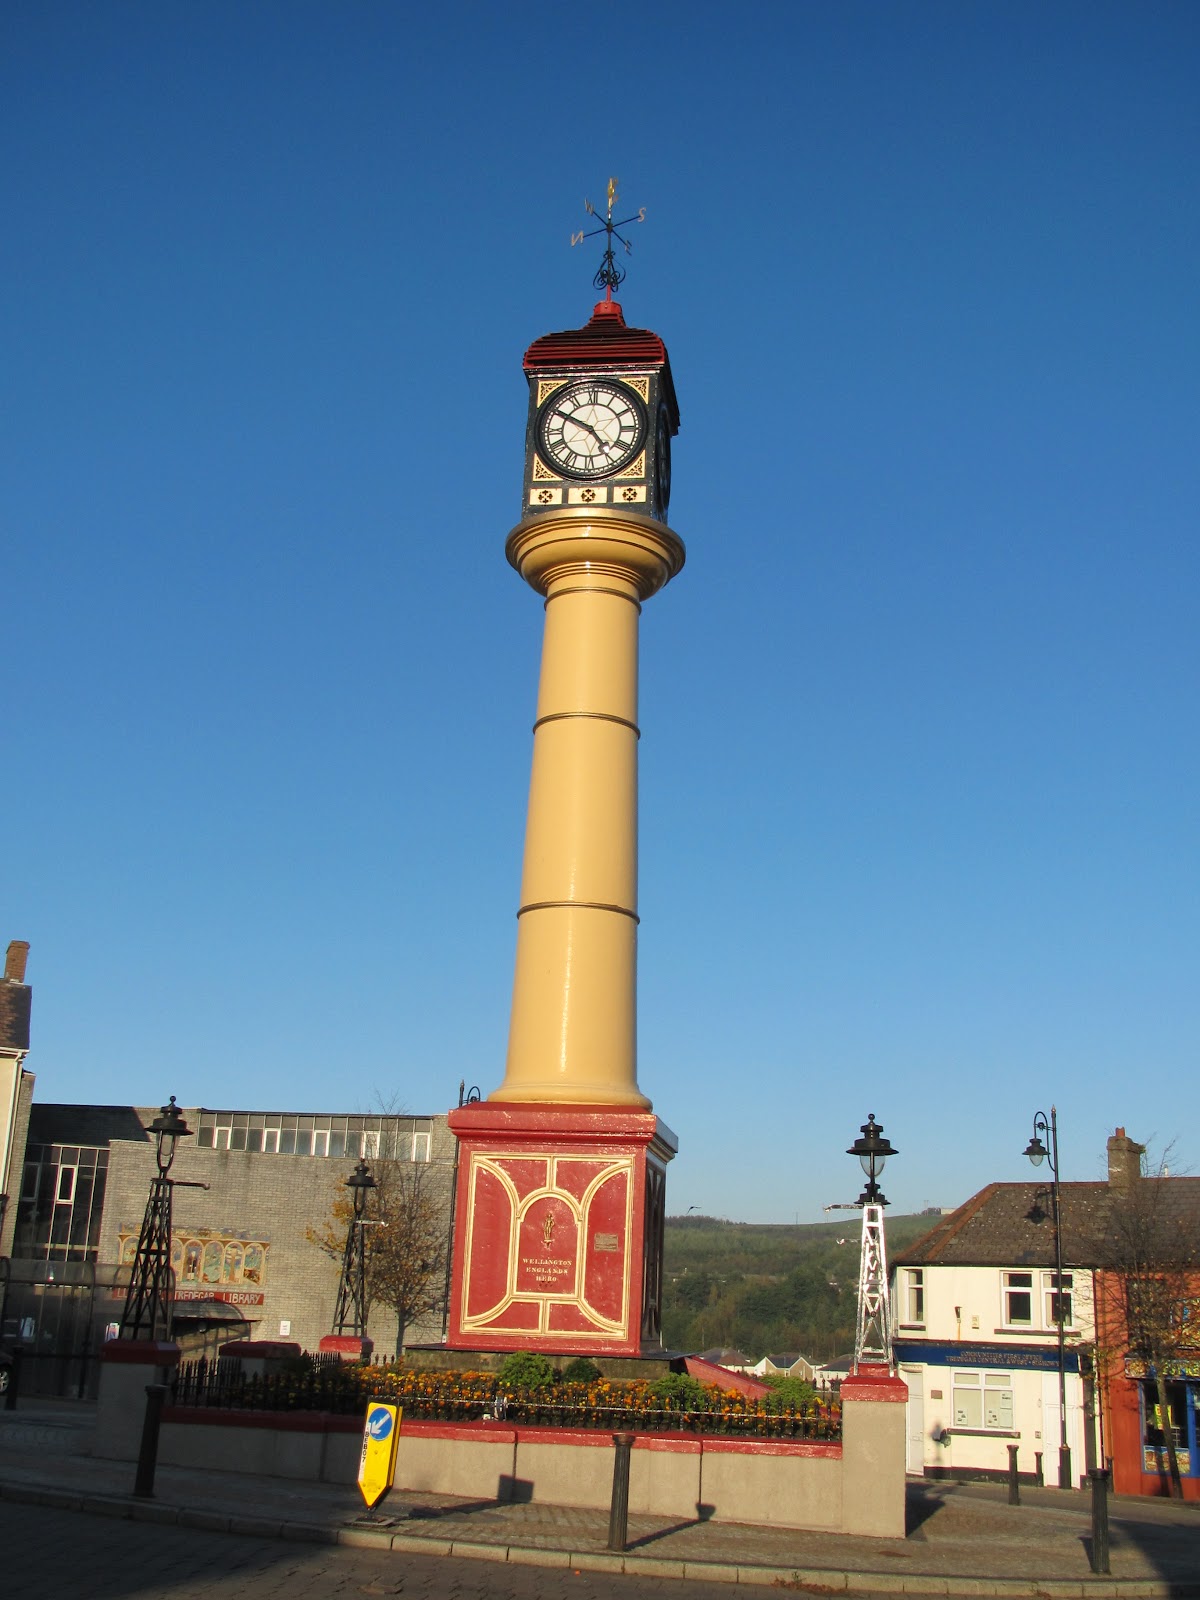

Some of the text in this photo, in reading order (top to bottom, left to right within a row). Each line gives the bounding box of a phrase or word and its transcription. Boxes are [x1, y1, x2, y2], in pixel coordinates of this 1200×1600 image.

[637, 207, 647, 223] S
[588, 391, 598, 404] XII
[522, 1258, 572, 1266] WELLINGTON
[174, 1291, 215, 1301] TREDEGAR
[222, 1292, 261, 1304] LIBRARY
